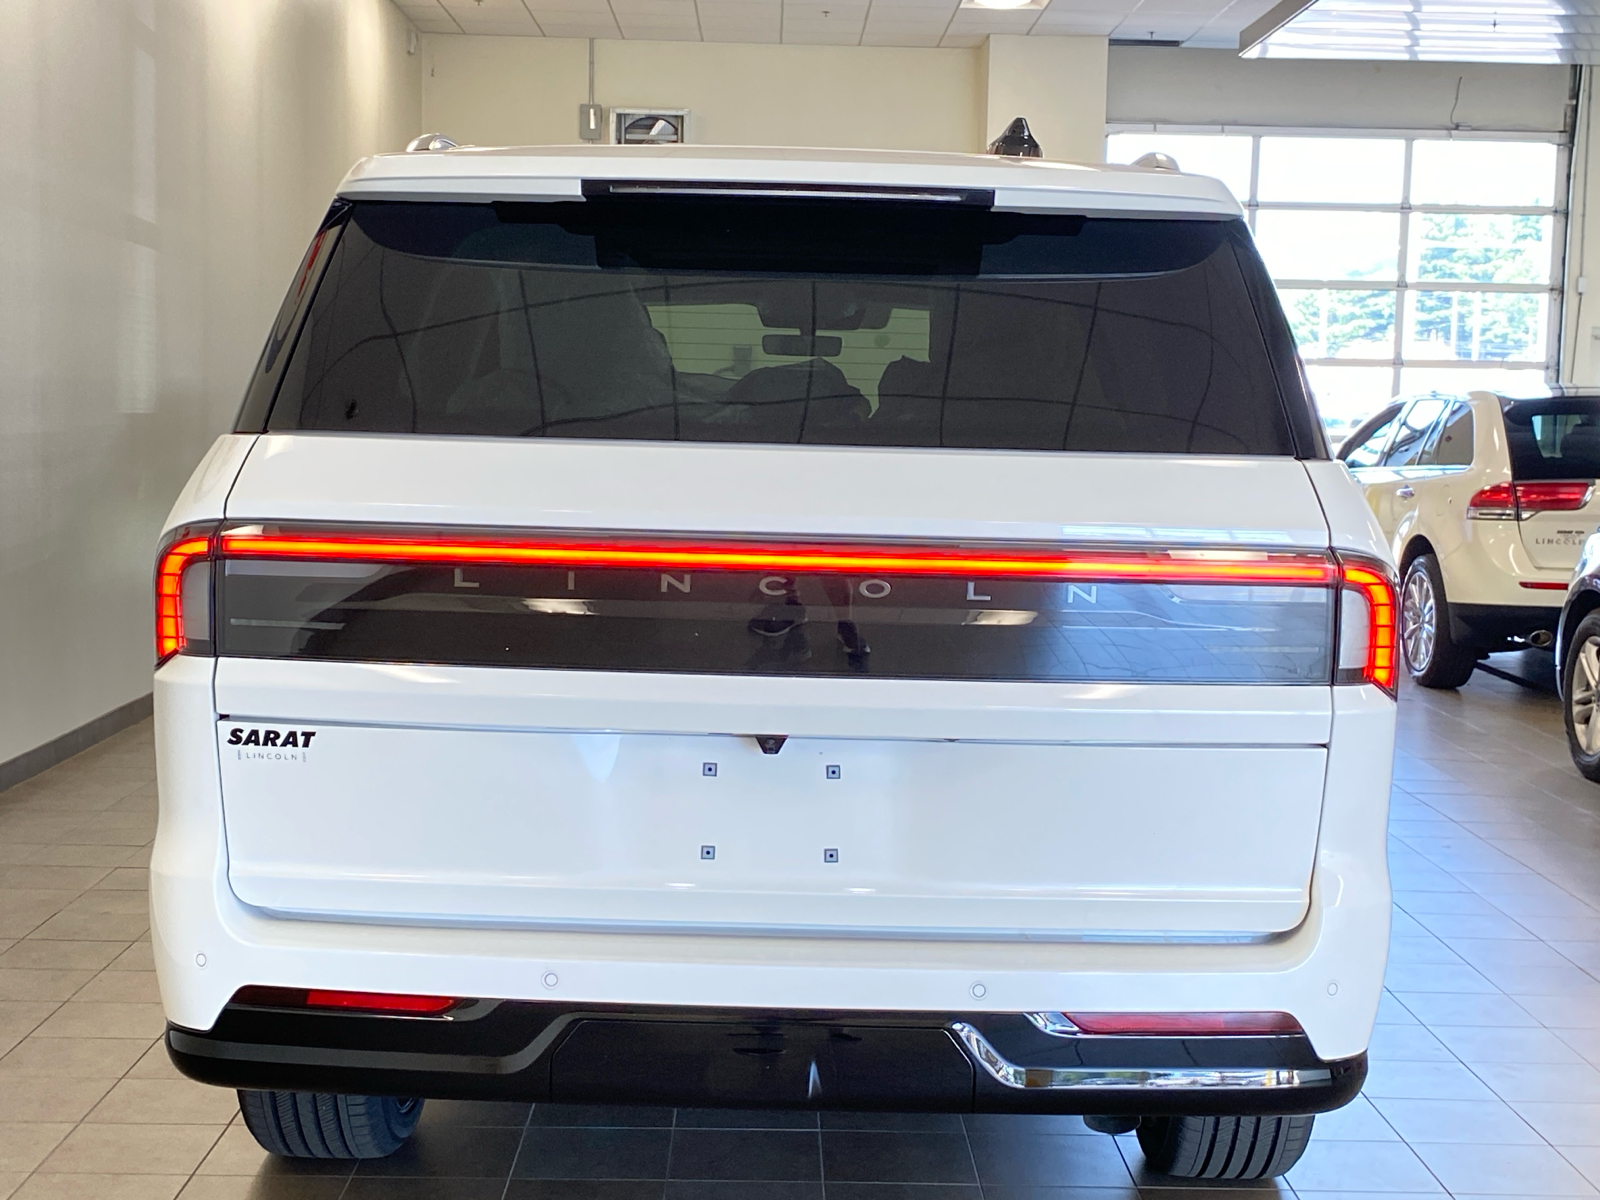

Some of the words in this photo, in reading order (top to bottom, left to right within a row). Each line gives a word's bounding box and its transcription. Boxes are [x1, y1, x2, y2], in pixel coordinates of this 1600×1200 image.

[453, 567, 1098, 604] LINCOLN
[227, 728, 316, 748] SARAT
[246, 752, 298, 760] LINCOLN
